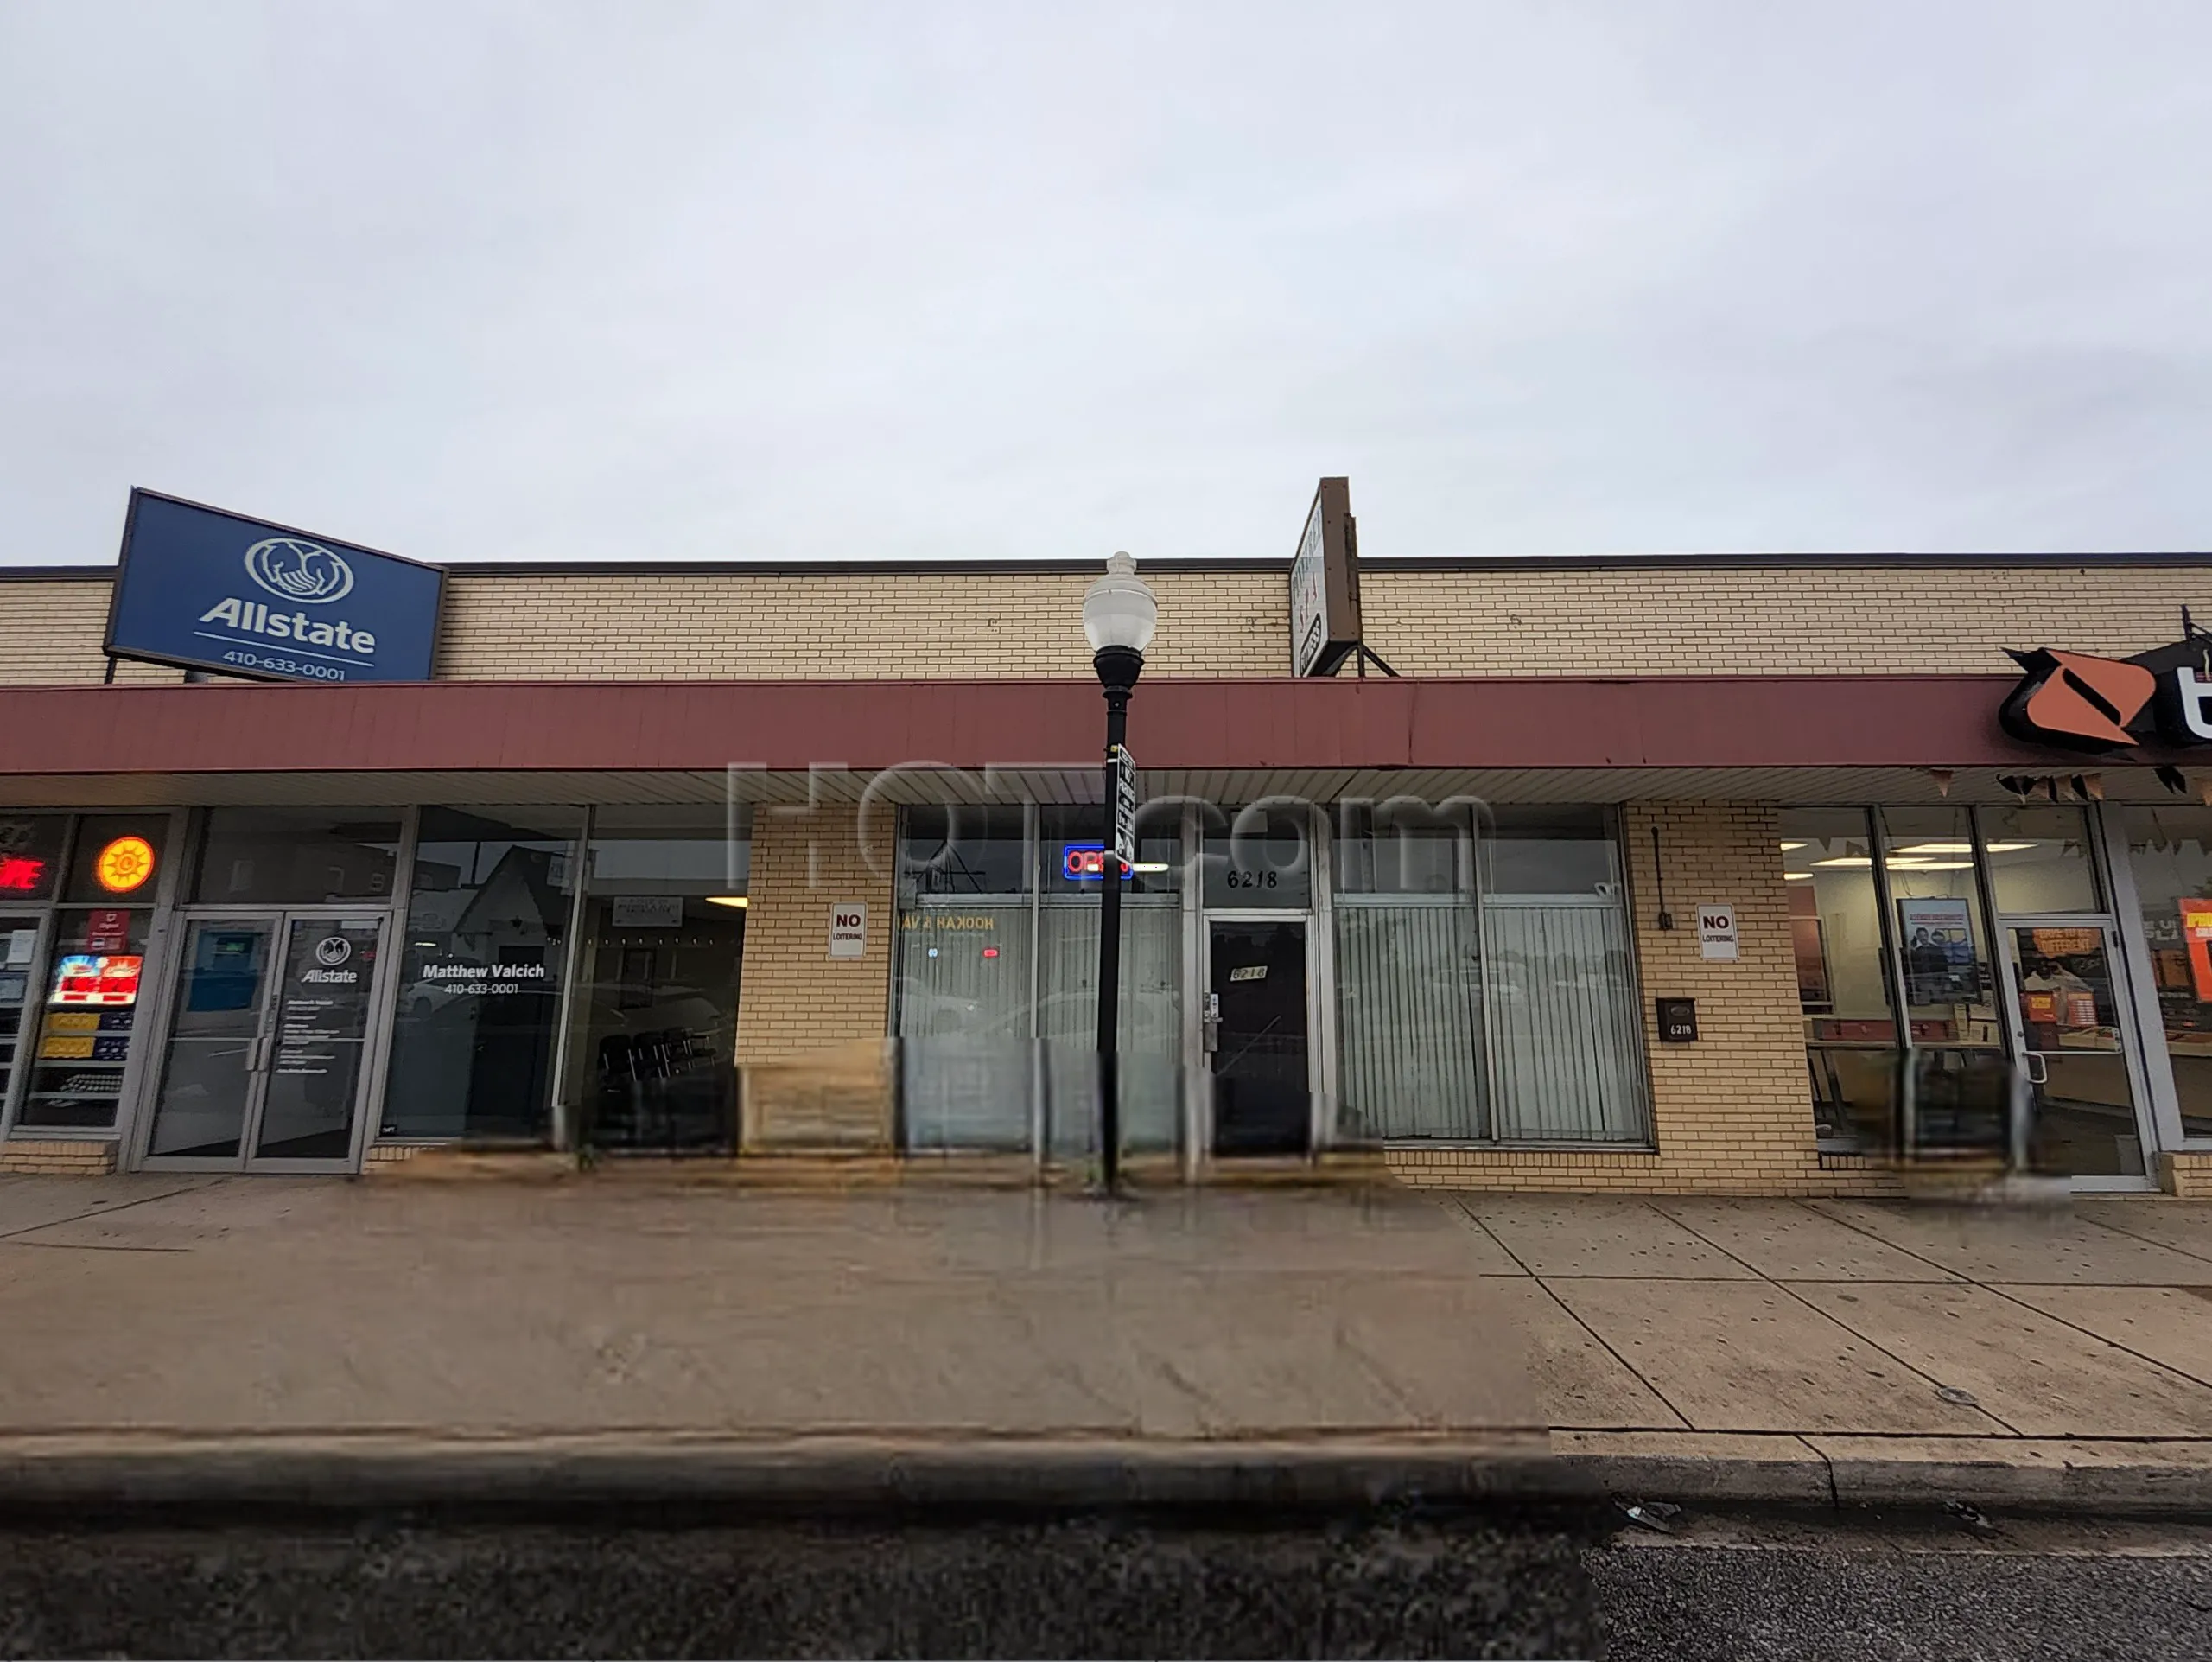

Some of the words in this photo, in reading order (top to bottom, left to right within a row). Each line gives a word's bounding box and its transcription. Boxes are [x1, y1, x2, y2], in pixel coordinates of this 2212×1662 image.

[199, 597, 376, 654] Allstate
[223, 649, 345, 682] 410-633-0001
[1227, 870, 1277, 888] 6218
[836, 914, 861, 927] NO
[1703, 915, 1729, 928] NO
[302, 969, 358, 983] Allstate
[423, 965, 488, 978] Matthew
[491, 964, 545, 977] Valcich
[1232, 968, 1265, 979] 6218
[444, 983, 518, 994] 410-633-0001
[1670, 1025, 1692, 1035] 6218
